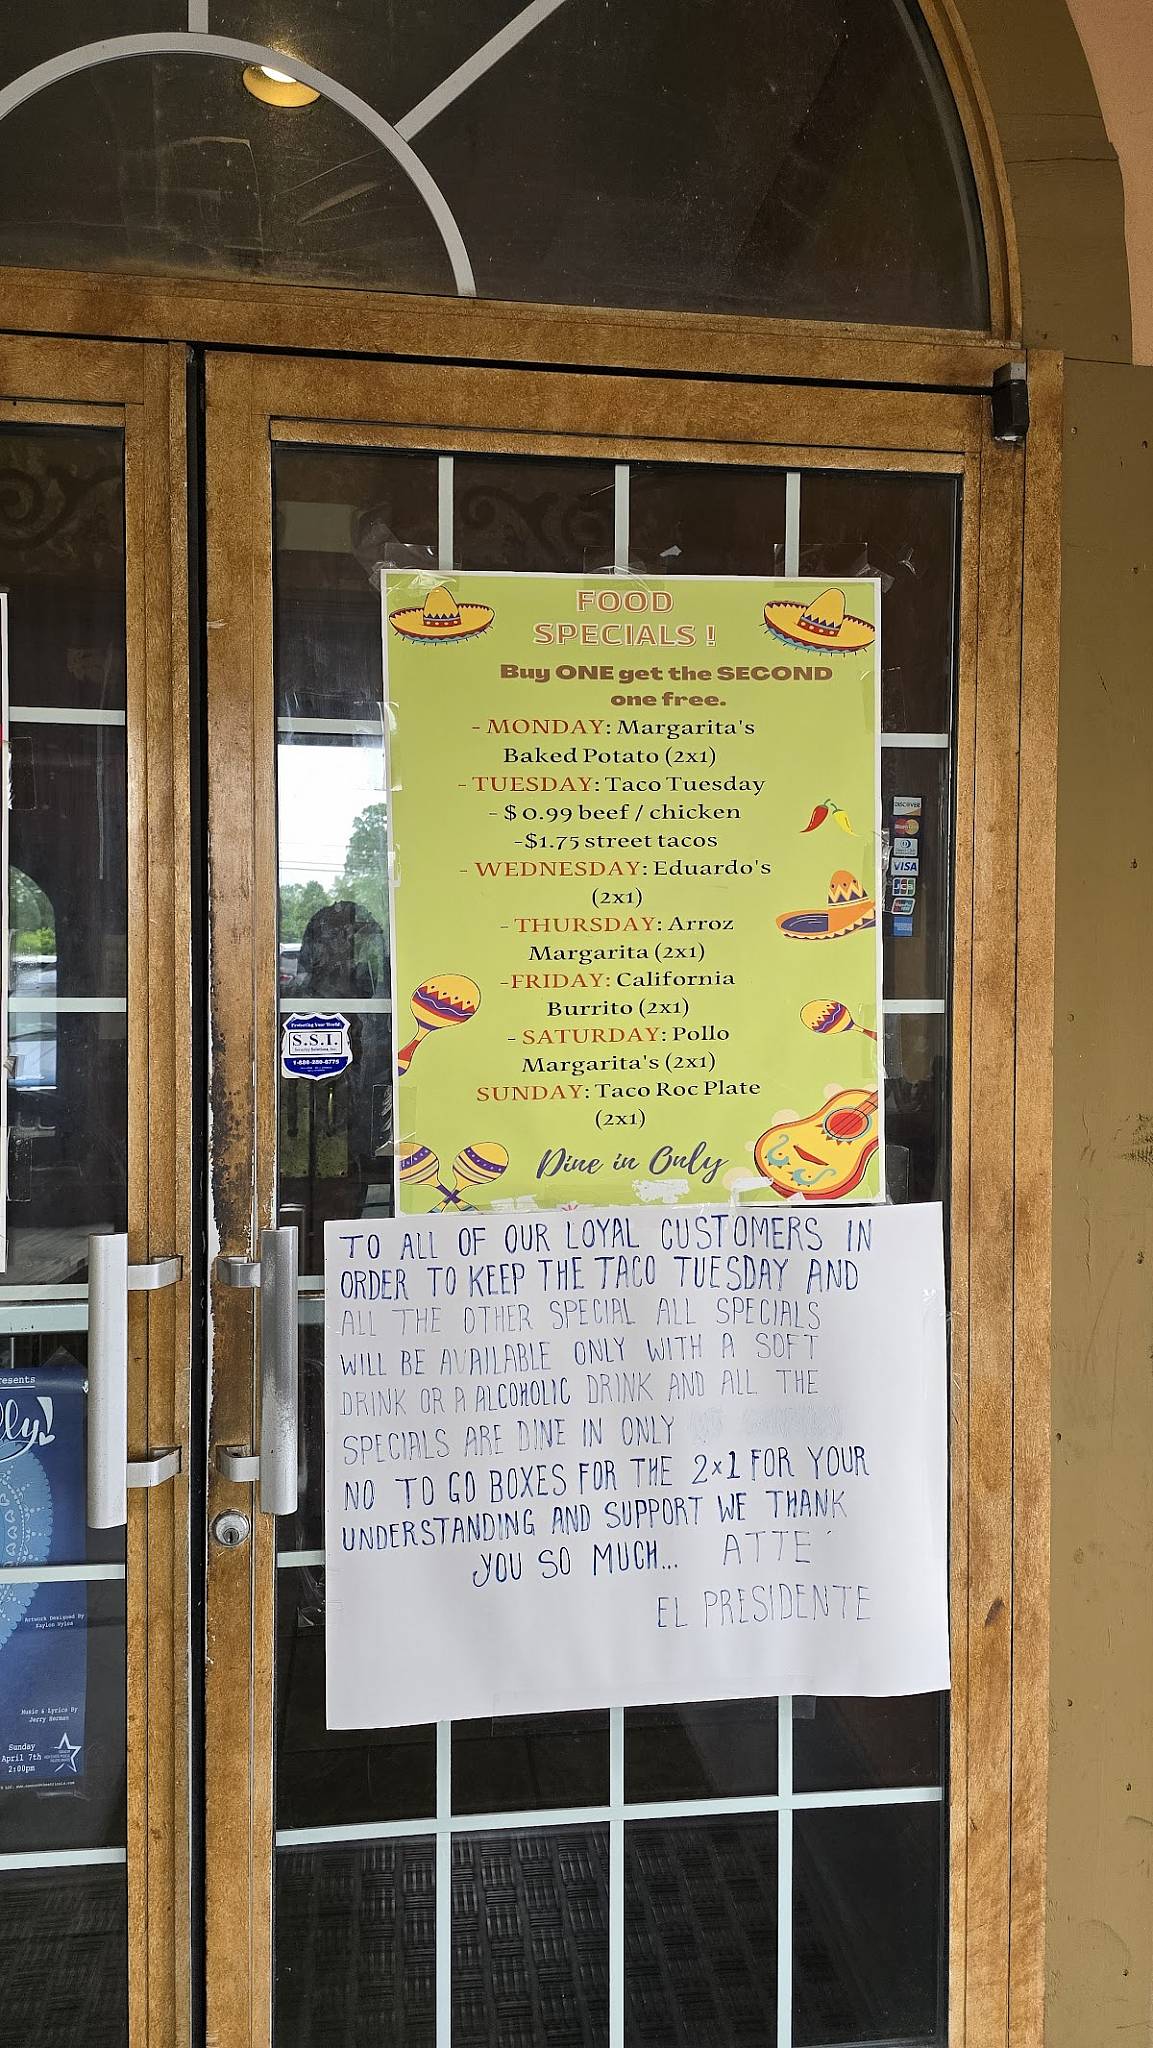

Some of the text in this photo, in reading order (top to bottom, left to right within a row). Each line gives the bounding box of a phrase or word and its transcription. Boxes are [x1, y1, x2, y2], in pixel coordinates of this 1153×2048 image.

[576, 590, 674, 613] FOOD
[534, 623, 696, 647] SPECIALS
[500, 664, 833, 684] Buy ONE get the SECOND
[611, 691, 727, 707] one free.
[487, 719, 611, 736] MONDAY:
[617, 719, 755, 739] Margarita's
[503, 746, 716, 768] Baked Potato (2x1)
[472, 776, 599, 793] TUESDAY:
[605, 777, 662, 792] Taco
[666, 777, 765, 796] Tuesday
[522, 806, 572, 824] 0.99
[578, 803, 631, 820] beef
[650, 803, 740, 820] chicken
[514, 832, 717, 851] -$1.75 street tacos
[474, 861, 648, 878] WEDNESDAY:
[654, 859, 771, 877] Eduardo's
[895, 862, 917, 871] VISA
[592, 887, 642, 908] (2x1)
[515, 917, 662, 933] THURSDAY:
[668, 916, 734, 931] Arroz
[529, 942, 705, 965] Margarita (2x1)
[616, 971, 735, 988] California
[547, 998, 689, 1019] Burrito (2x1)
[293, 1034, 337, 1046] S.S.I.
[522, 1027, 667, 1045] SATURDAY:
[673, 1026, 729, 1041] Pollo
[522, 1053, 715, 1076] Margarita's (2x1)
[476, 1080, 761, 1102] SUNDAY: Taco Roc Plate
[595, 1109, 645, 1131] (2x1)
[536, 1142, 728, 1181] Dine in Only
[339, 1215, 872, 1260] TO ALL OF OUR LOYAL CUSTOMERS IN
[340, 1255, 858, 1300] ORDER TO KEEP THE TACO TUESDAY AND
[340, 1297, 821, 1337] ALL THE OTHER SPECIAL ALL SPECIALS
[340, 1332, 818, 1376] WILL BE AVAILABLE ONLY WITH A SOFT
[339, 1369, 818, 1417] DRINK OR A ALCOHOLIC DRINK AND ALL THE
[343, 1414, 674, 1466] SPECIALS ARE DINE IN ONLY
[344, 1479, 374, 1511] NO
[395, 1476, 434, 1508] TO
[448, 1470, 476, 1504] GO
[490, 1463, 567, 1502] BOXES
[578, 1460, 617, 1494] FOR
[630, 1456, 673, 1487] THE
[750, 1447, 795, 1481] FOR
[807, 1446, 870, 1480] YOUR
[342, 1488, 847, 1550] UNDERSTANDING AND SUPPORT WE THANK
[472, 1552, 522, 1587] YOU
[538, 1546, 570, 1578] SO
[592, 1540, 678, 1576] MUCH...
[657, 1584, 873, 1629] EL PRESIDENTE
[9, 1743, 35, 1751] Sunday
[2, 1754, 24, 1763] April
[9, 1765, 35, 1773] 2:00pm
